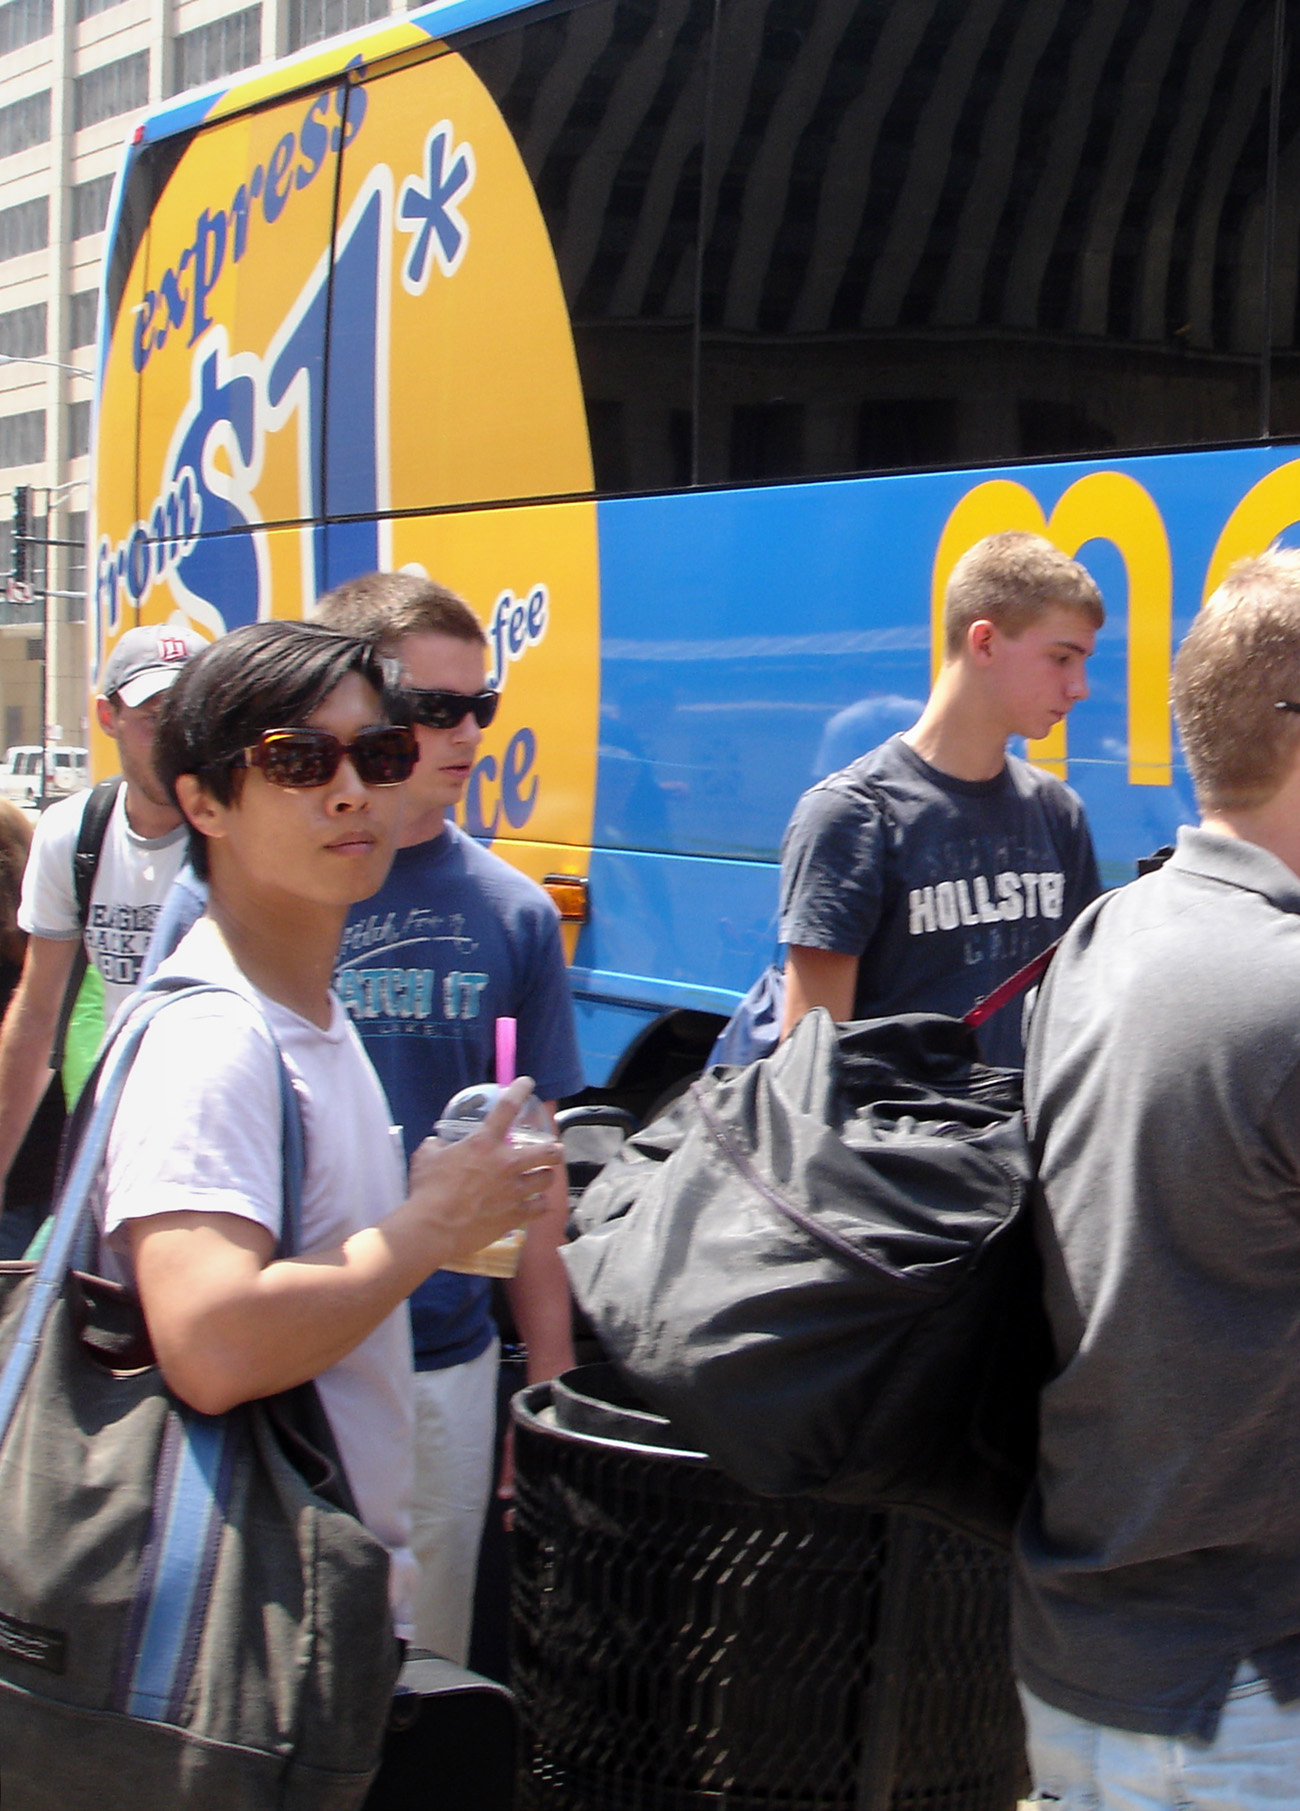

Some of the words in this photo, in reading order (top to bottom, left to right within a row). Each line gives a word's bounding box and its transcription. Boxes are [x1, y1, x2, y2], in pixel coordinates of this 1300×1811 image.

[132, 53, 369, 374] express
[91, 465, 202, 690] from
[443, 970, 490, 1020] IT
